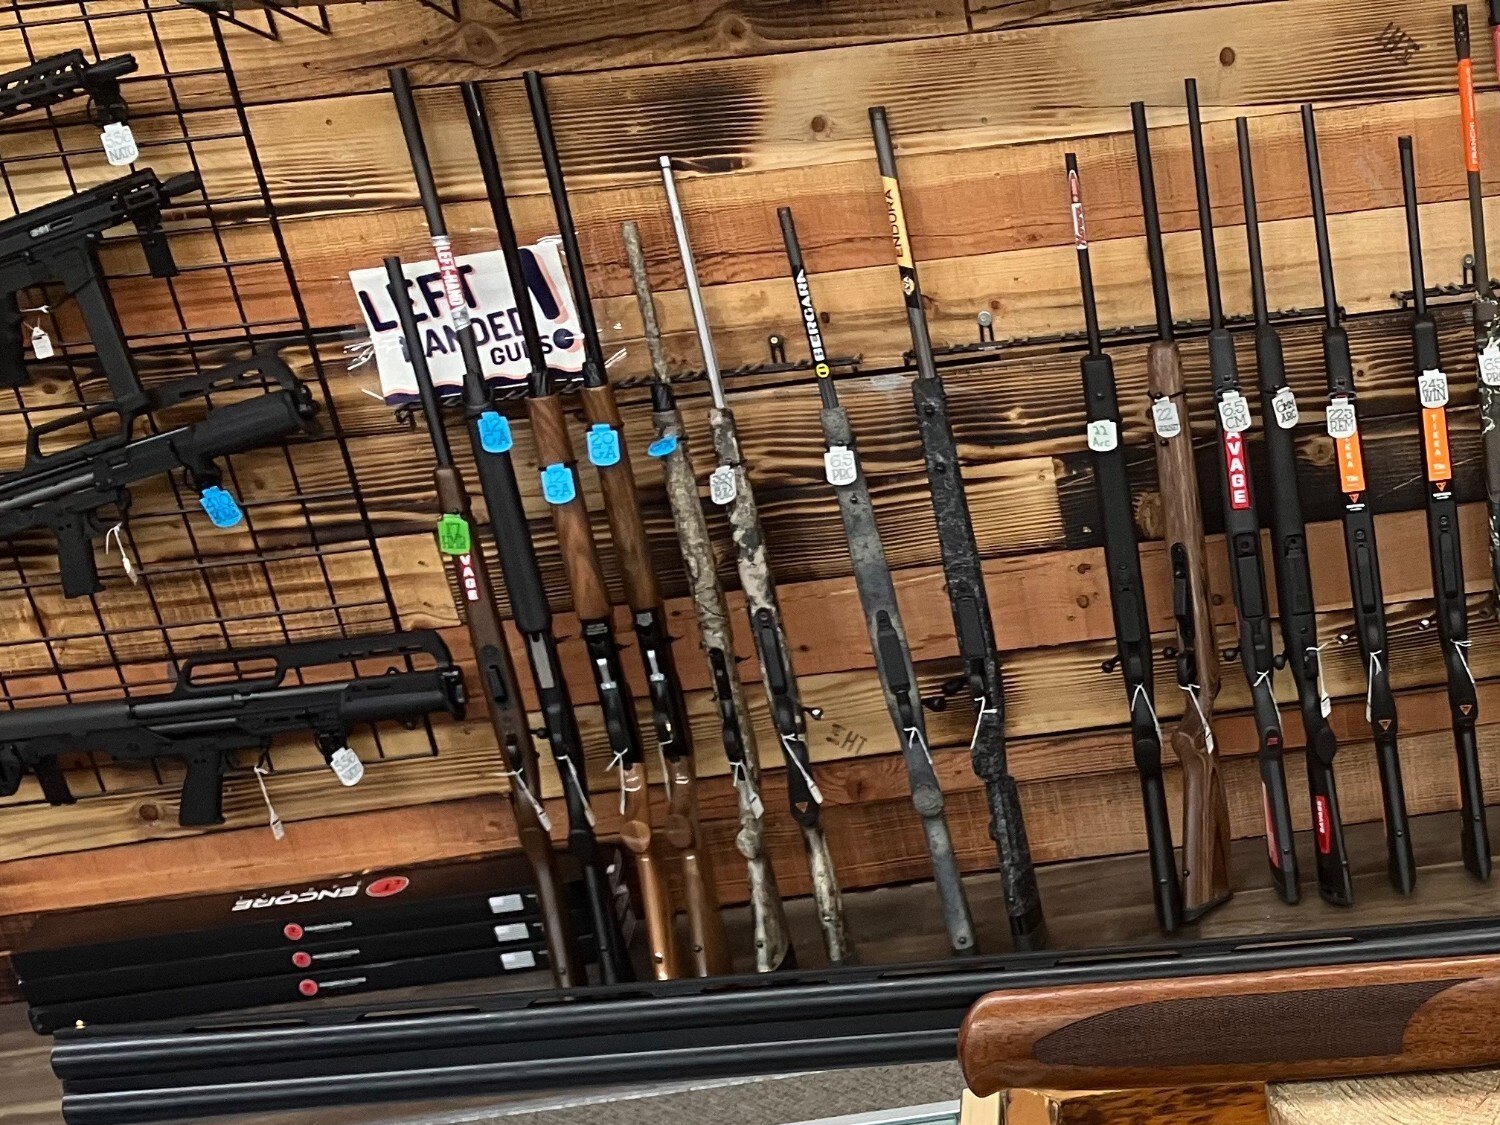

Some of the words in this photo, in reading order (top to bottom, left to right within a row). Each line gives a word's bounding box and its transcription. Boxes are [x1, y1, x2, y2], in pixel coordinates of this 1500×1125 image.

[796, 268, 826, 362] BERGARA
[490, 335, 553, 365] GUS
[1420, 378, 1446, 390] 243
[1422, 387, 1447, 403] WIN
[1156, 407, 1174, 421] 22
[1328, 408, 1354, 421] 223
[483, 418, 501, 433] 12
[1225, 414, 1249, 430] CM
[1330, 419, 1355, 433] REM
[1092, 425, 1110, 436] 22
[1430, 413, 1443, 457] TIKKA
[484, 432, 509, 447] GA
[590, 432, 615, 445] 20
[591, 445, 618, 460] GA
[831, 467, 855, 481] PRC
[1226, 432, 1247, 504] AVAGE
[459, 554, 479, 601] VAGE
[231, 884, 360, 911] ENCORE
